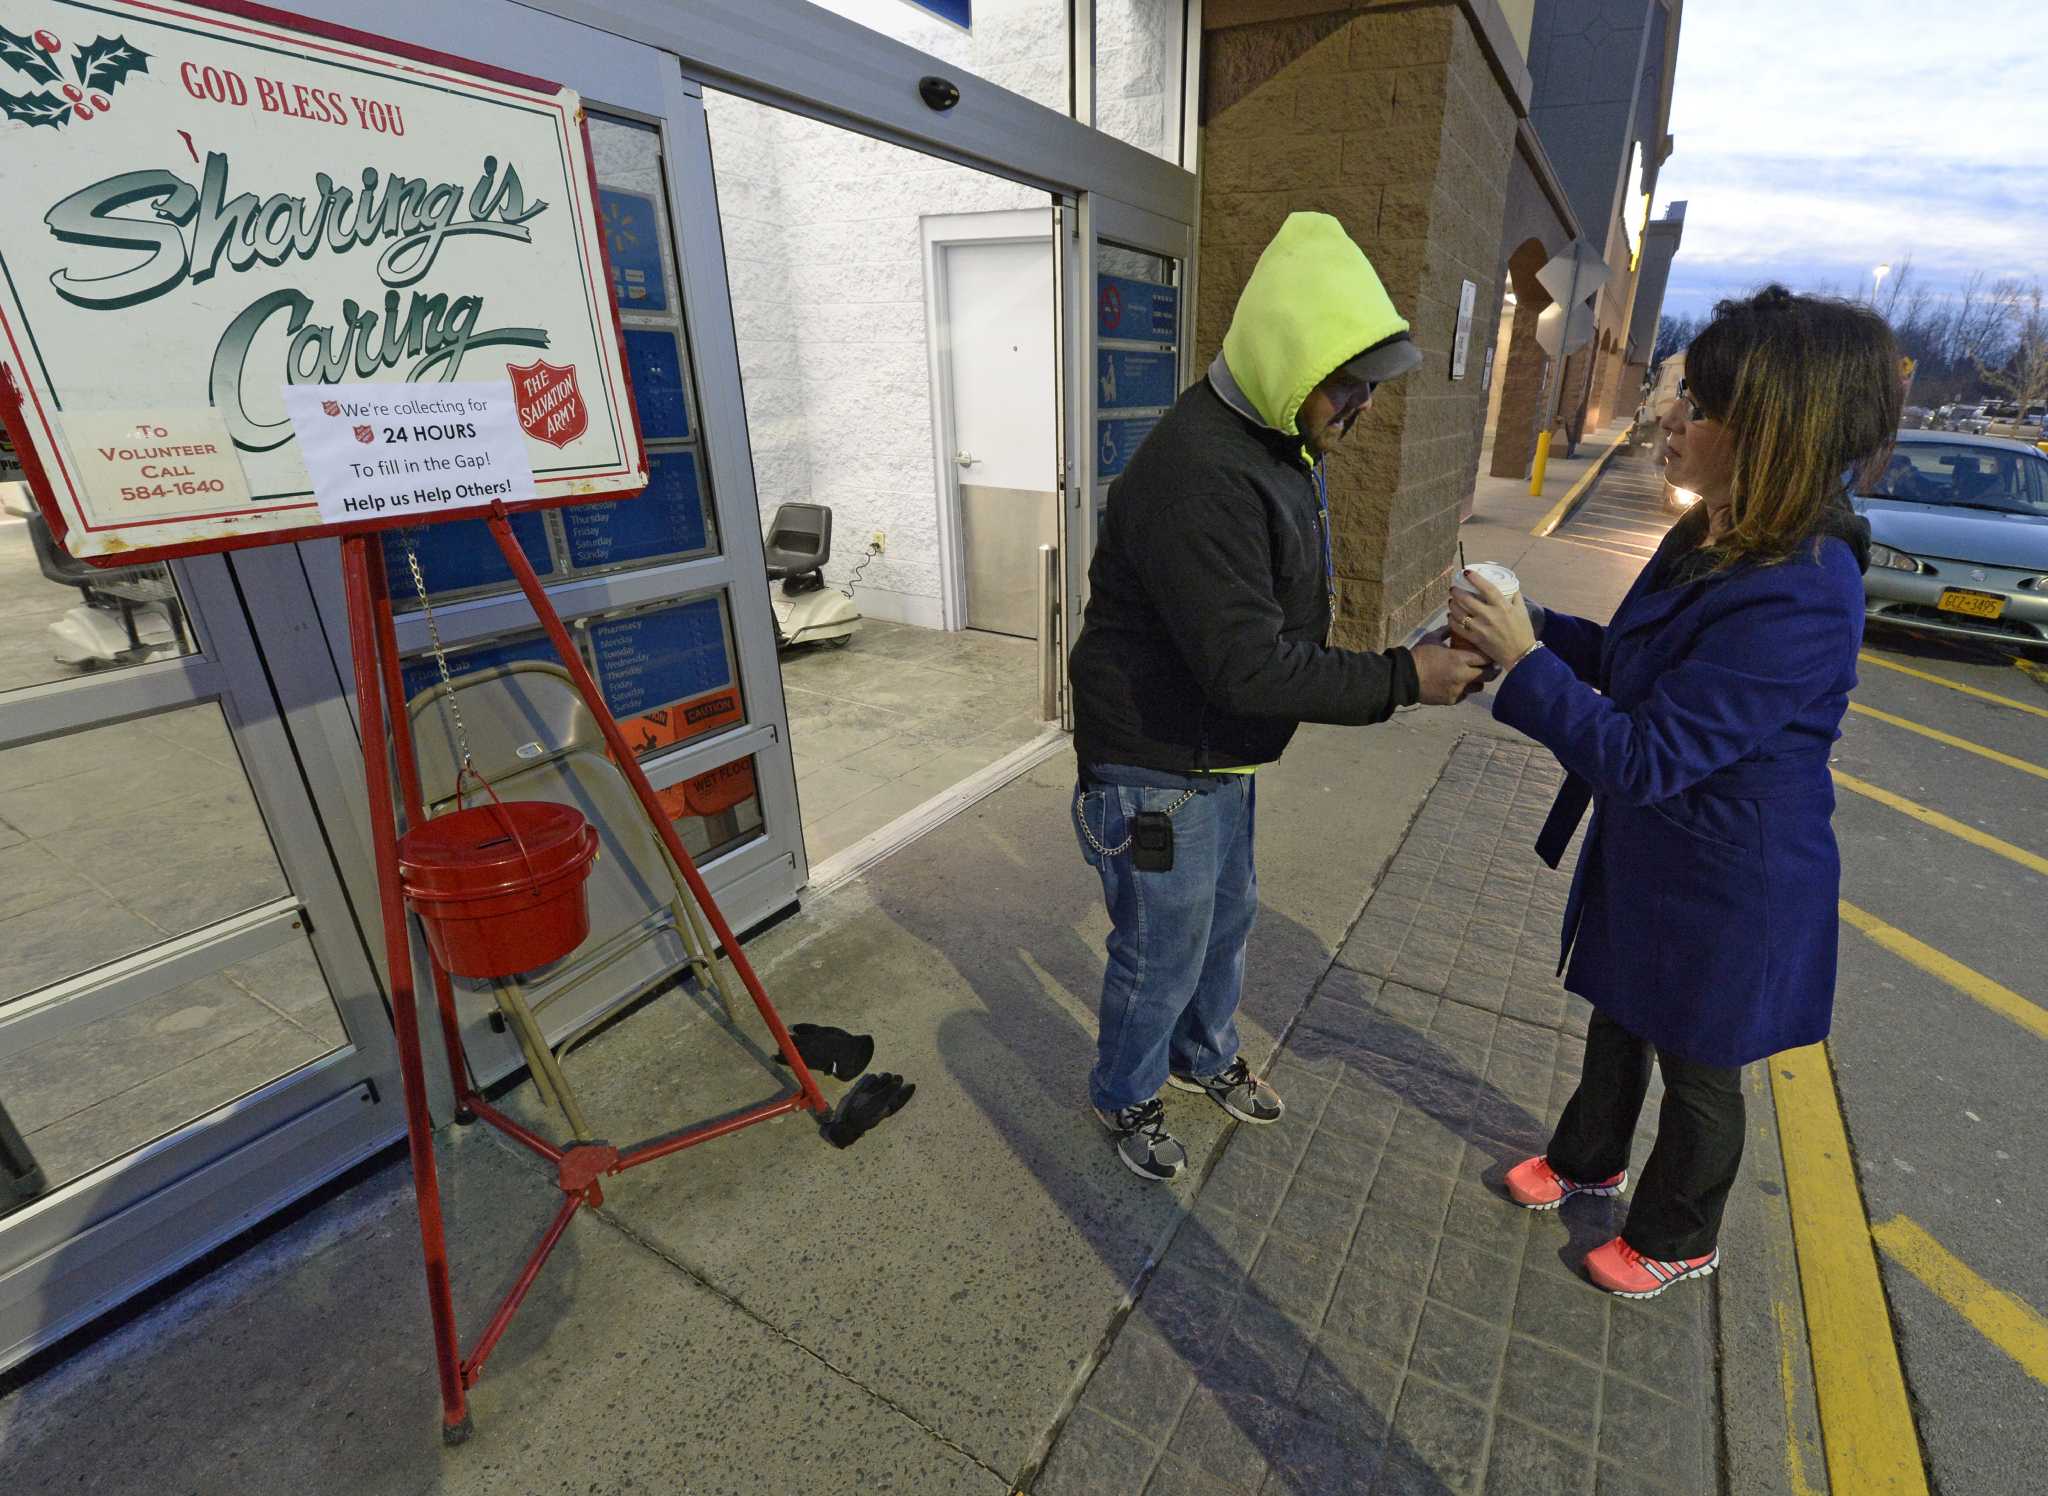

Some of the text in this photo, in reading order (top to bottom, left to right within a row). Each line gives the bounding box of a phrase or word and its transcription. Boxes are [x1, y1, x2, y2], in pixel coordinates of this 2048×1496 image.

[180, 61, 405, 136] GOD BLESS YOU
[44, 151, 549, 311] Sharing is
[209, 288, 551, 453] Caring
[523, 370, 549, 398] THE
[341, 402, 389, 417] We're
[394, 400, 465, 415] collecting
[468, 398, 488, 411] for
[521, 373, 574, 428] SALVATION
[547, 398, 576, 438] ARMY
[383, 427, 408, 443] 24
[414, 423, 476, 441] HOURS
[350, 451, 491, 478] To fill in the Gap!
[120, 479, 224, 501] 584-1640
[344, 479, 512, 512] Help us Help Others!
[573, 527, 600, 538] Friday
[598, 621, 642, 636] Pharmacy
[687, 698, 734, 720] CAUTION
[695, 773, 717, 791] WET
[719, 758, 752, 779] FLOO
